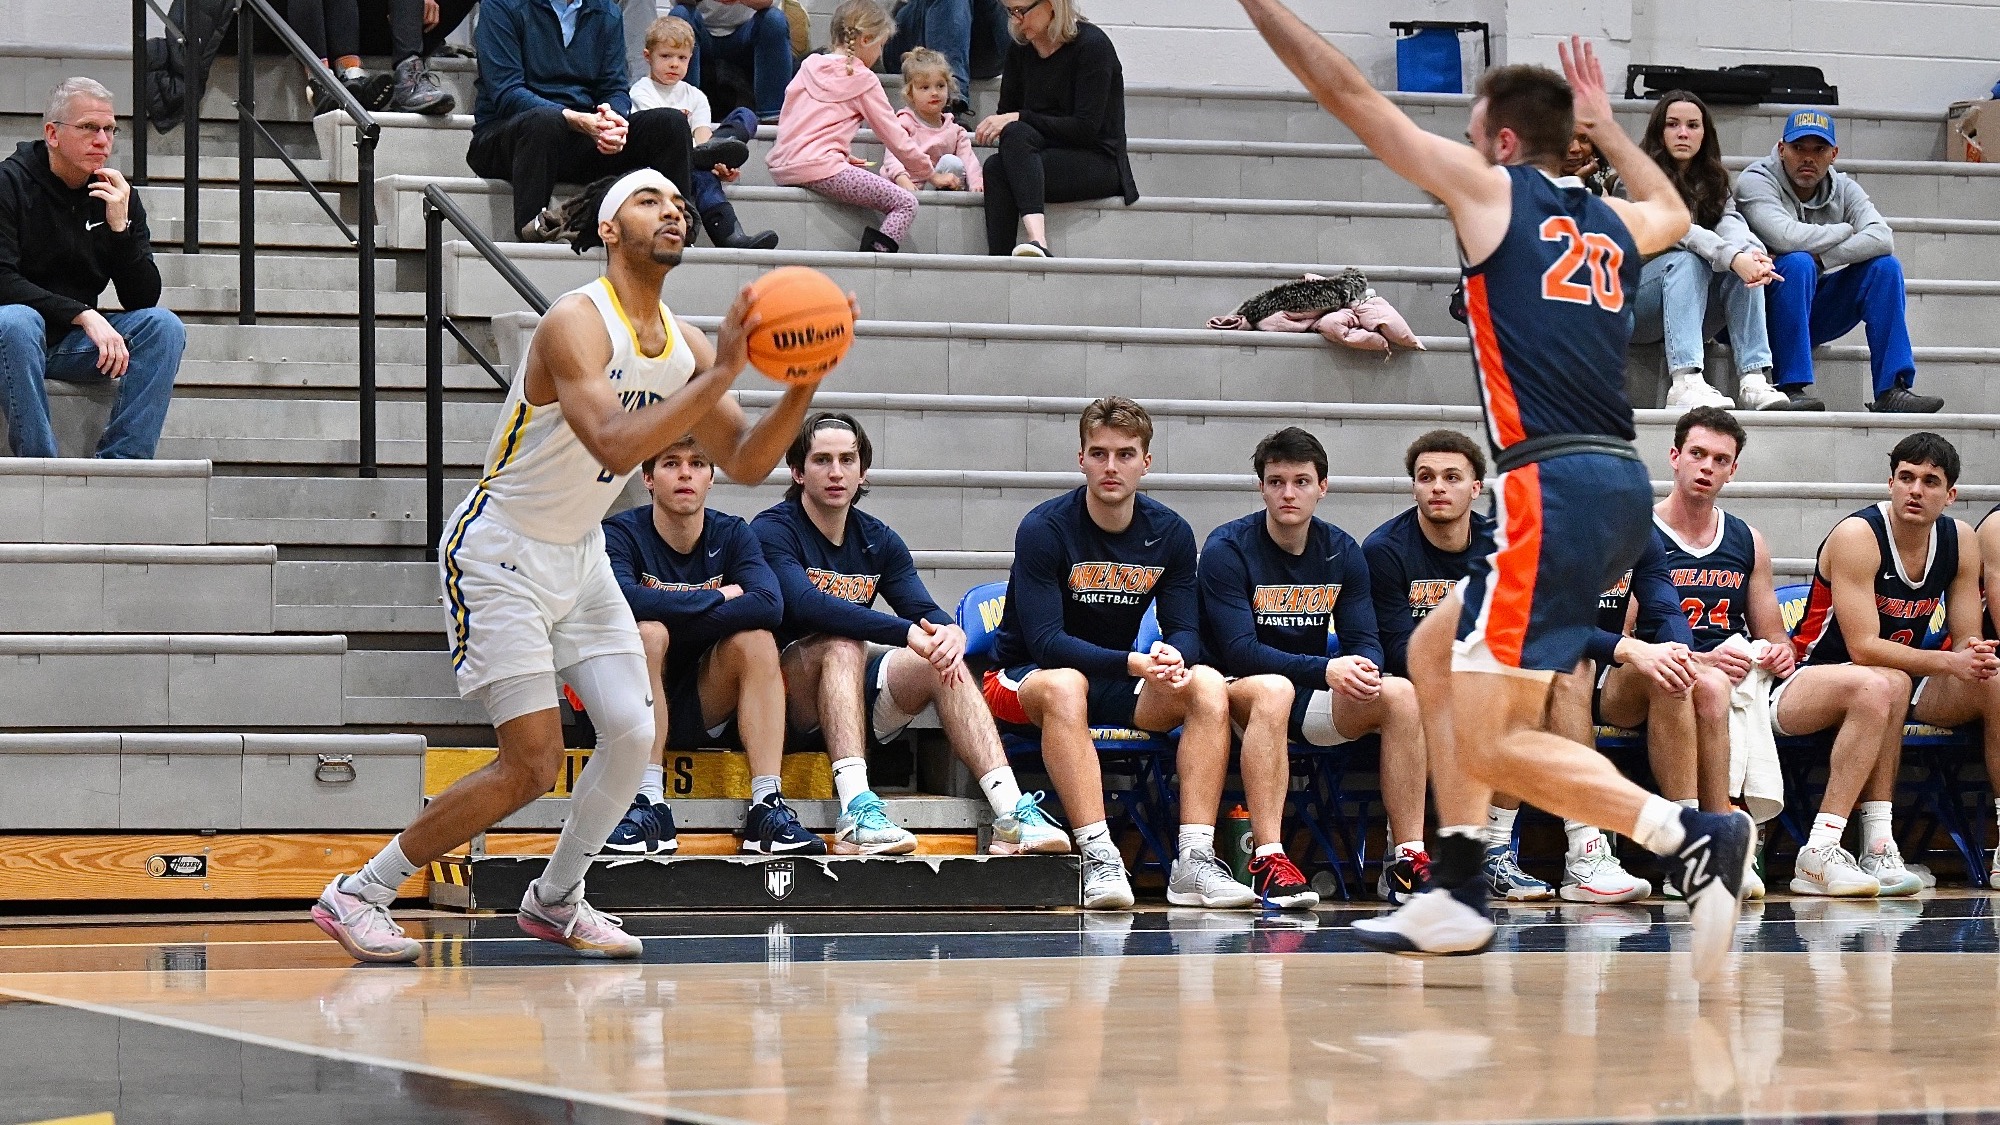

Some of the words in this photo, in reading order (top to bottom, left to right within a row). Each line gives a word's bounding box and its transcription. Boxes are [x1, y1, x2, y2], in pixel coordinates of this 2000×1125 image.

[1539, 215, 1625, 313] 20
[1067, 561, 1165, 595] WHEATON
[1669, 568, 1745, 589] HEATON
[1072, 593, 1140, 605] BASKETBALL
[1253, 584, 1342, 615] WHEATON
[1257, 616, 1324, 627] BASKETBALL
[1680, 597, 1730, 631] 24
[767, 870, 792, 897] NP
